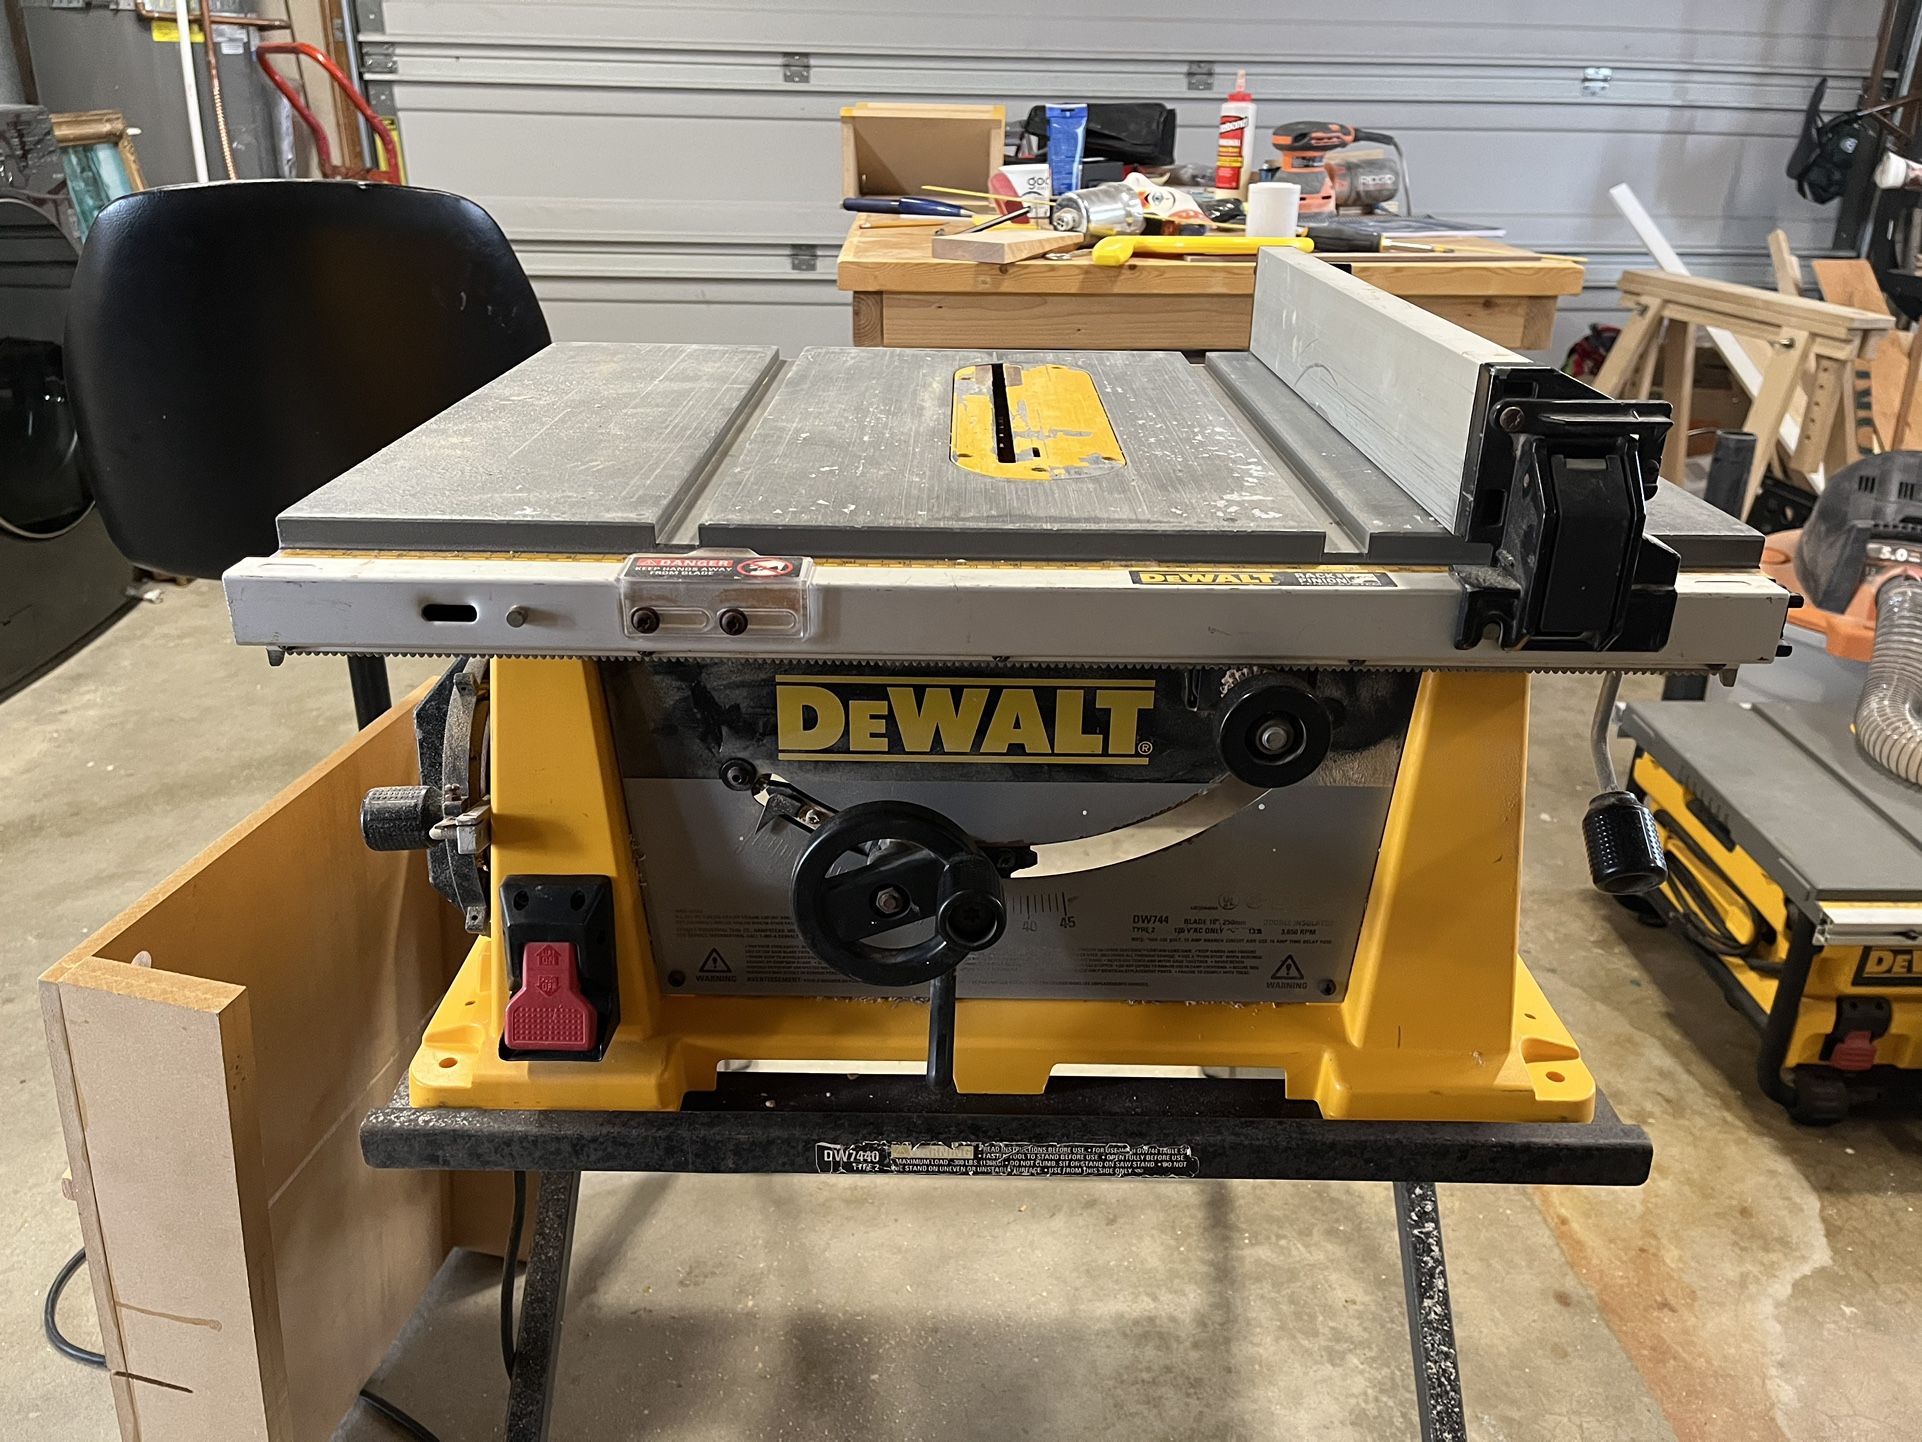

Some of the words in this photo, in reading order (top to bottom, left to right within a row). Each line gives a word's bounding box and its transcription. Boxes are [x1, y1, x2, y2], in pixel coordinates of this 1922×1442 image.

[1060, 915, 1076, 928] 45
[1132, 914, 1169, 924] DW744
[1266, 981, 1308, 989] WARNING
[1048, 1146, 1071, 1154] BEFORE
[824, 1149, 880, 1162] DW7440
